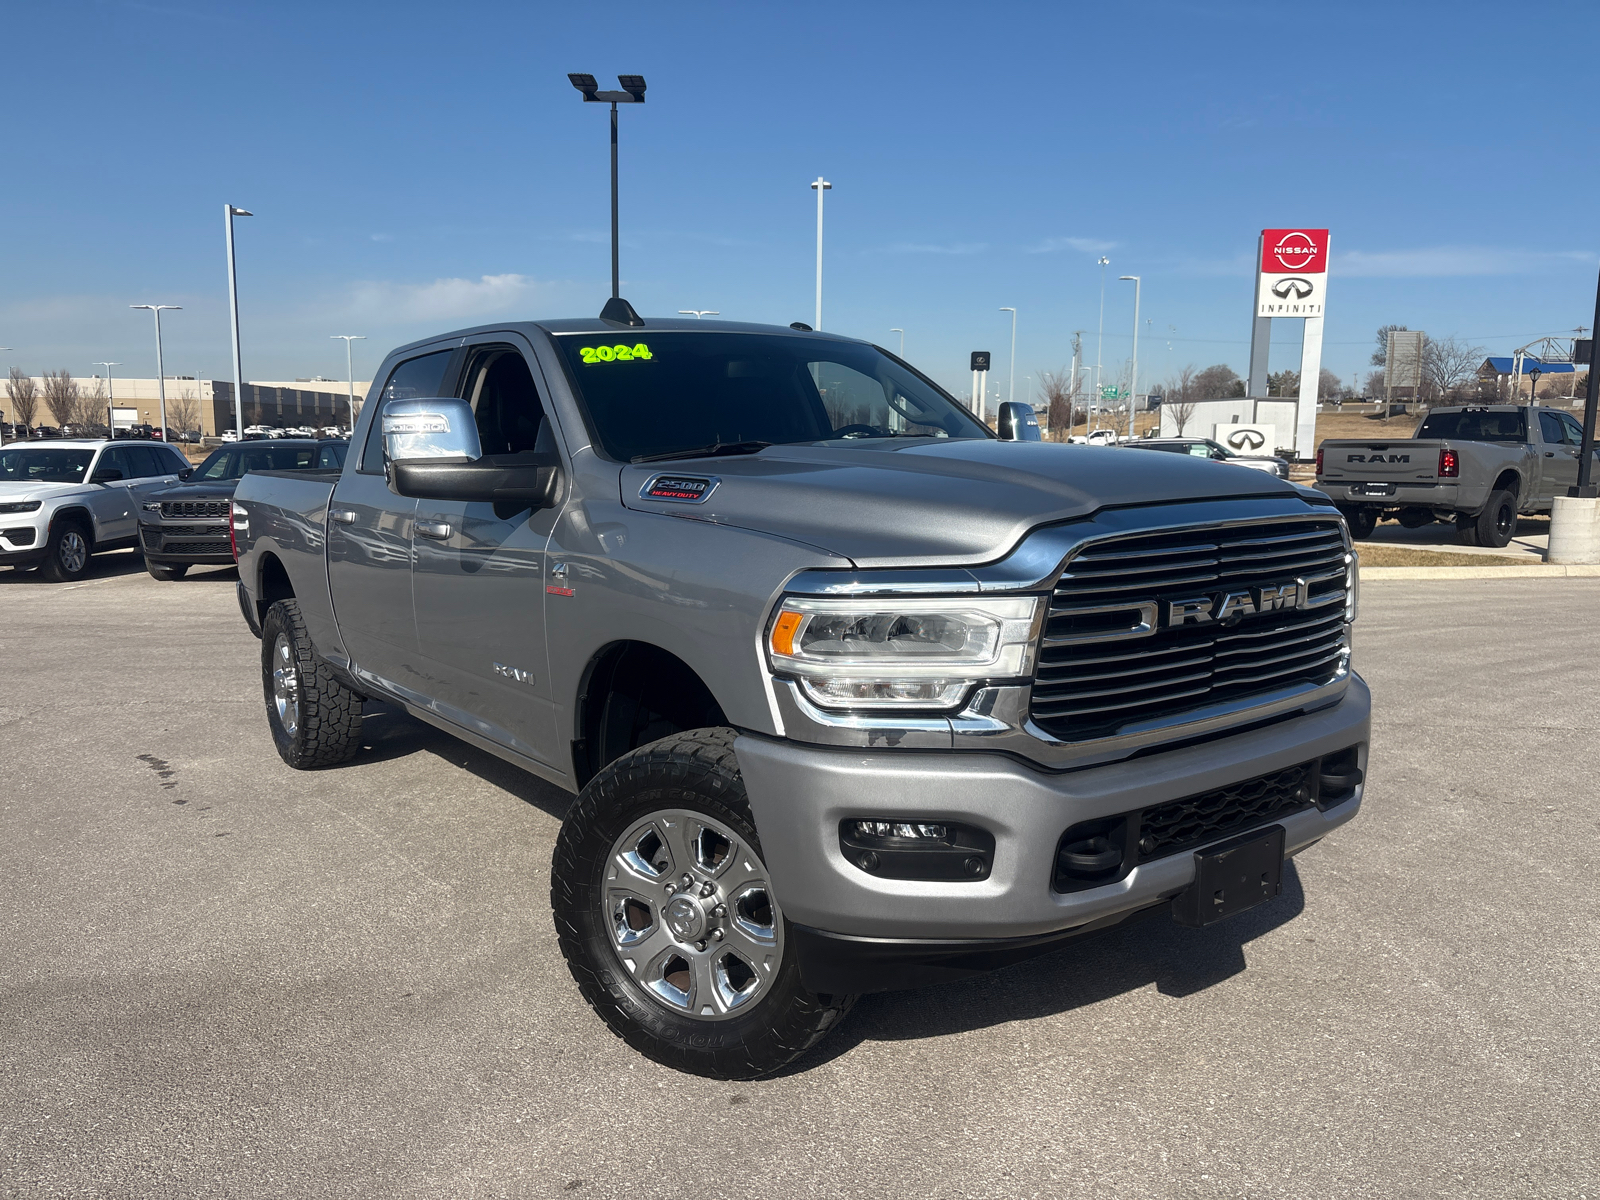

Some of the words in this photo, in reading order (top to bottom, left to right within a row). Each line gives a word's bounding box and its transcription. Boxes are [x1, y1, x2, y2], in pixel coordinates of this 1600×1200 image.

[1261, 304, 1321, 313] INFINITI
[580, 343, 653, 363] 2024
[1347, 454, 1410, 463] RAM
[656, 479, 705, 491] 2500
[1168, 582, 1297, 627] RAM
